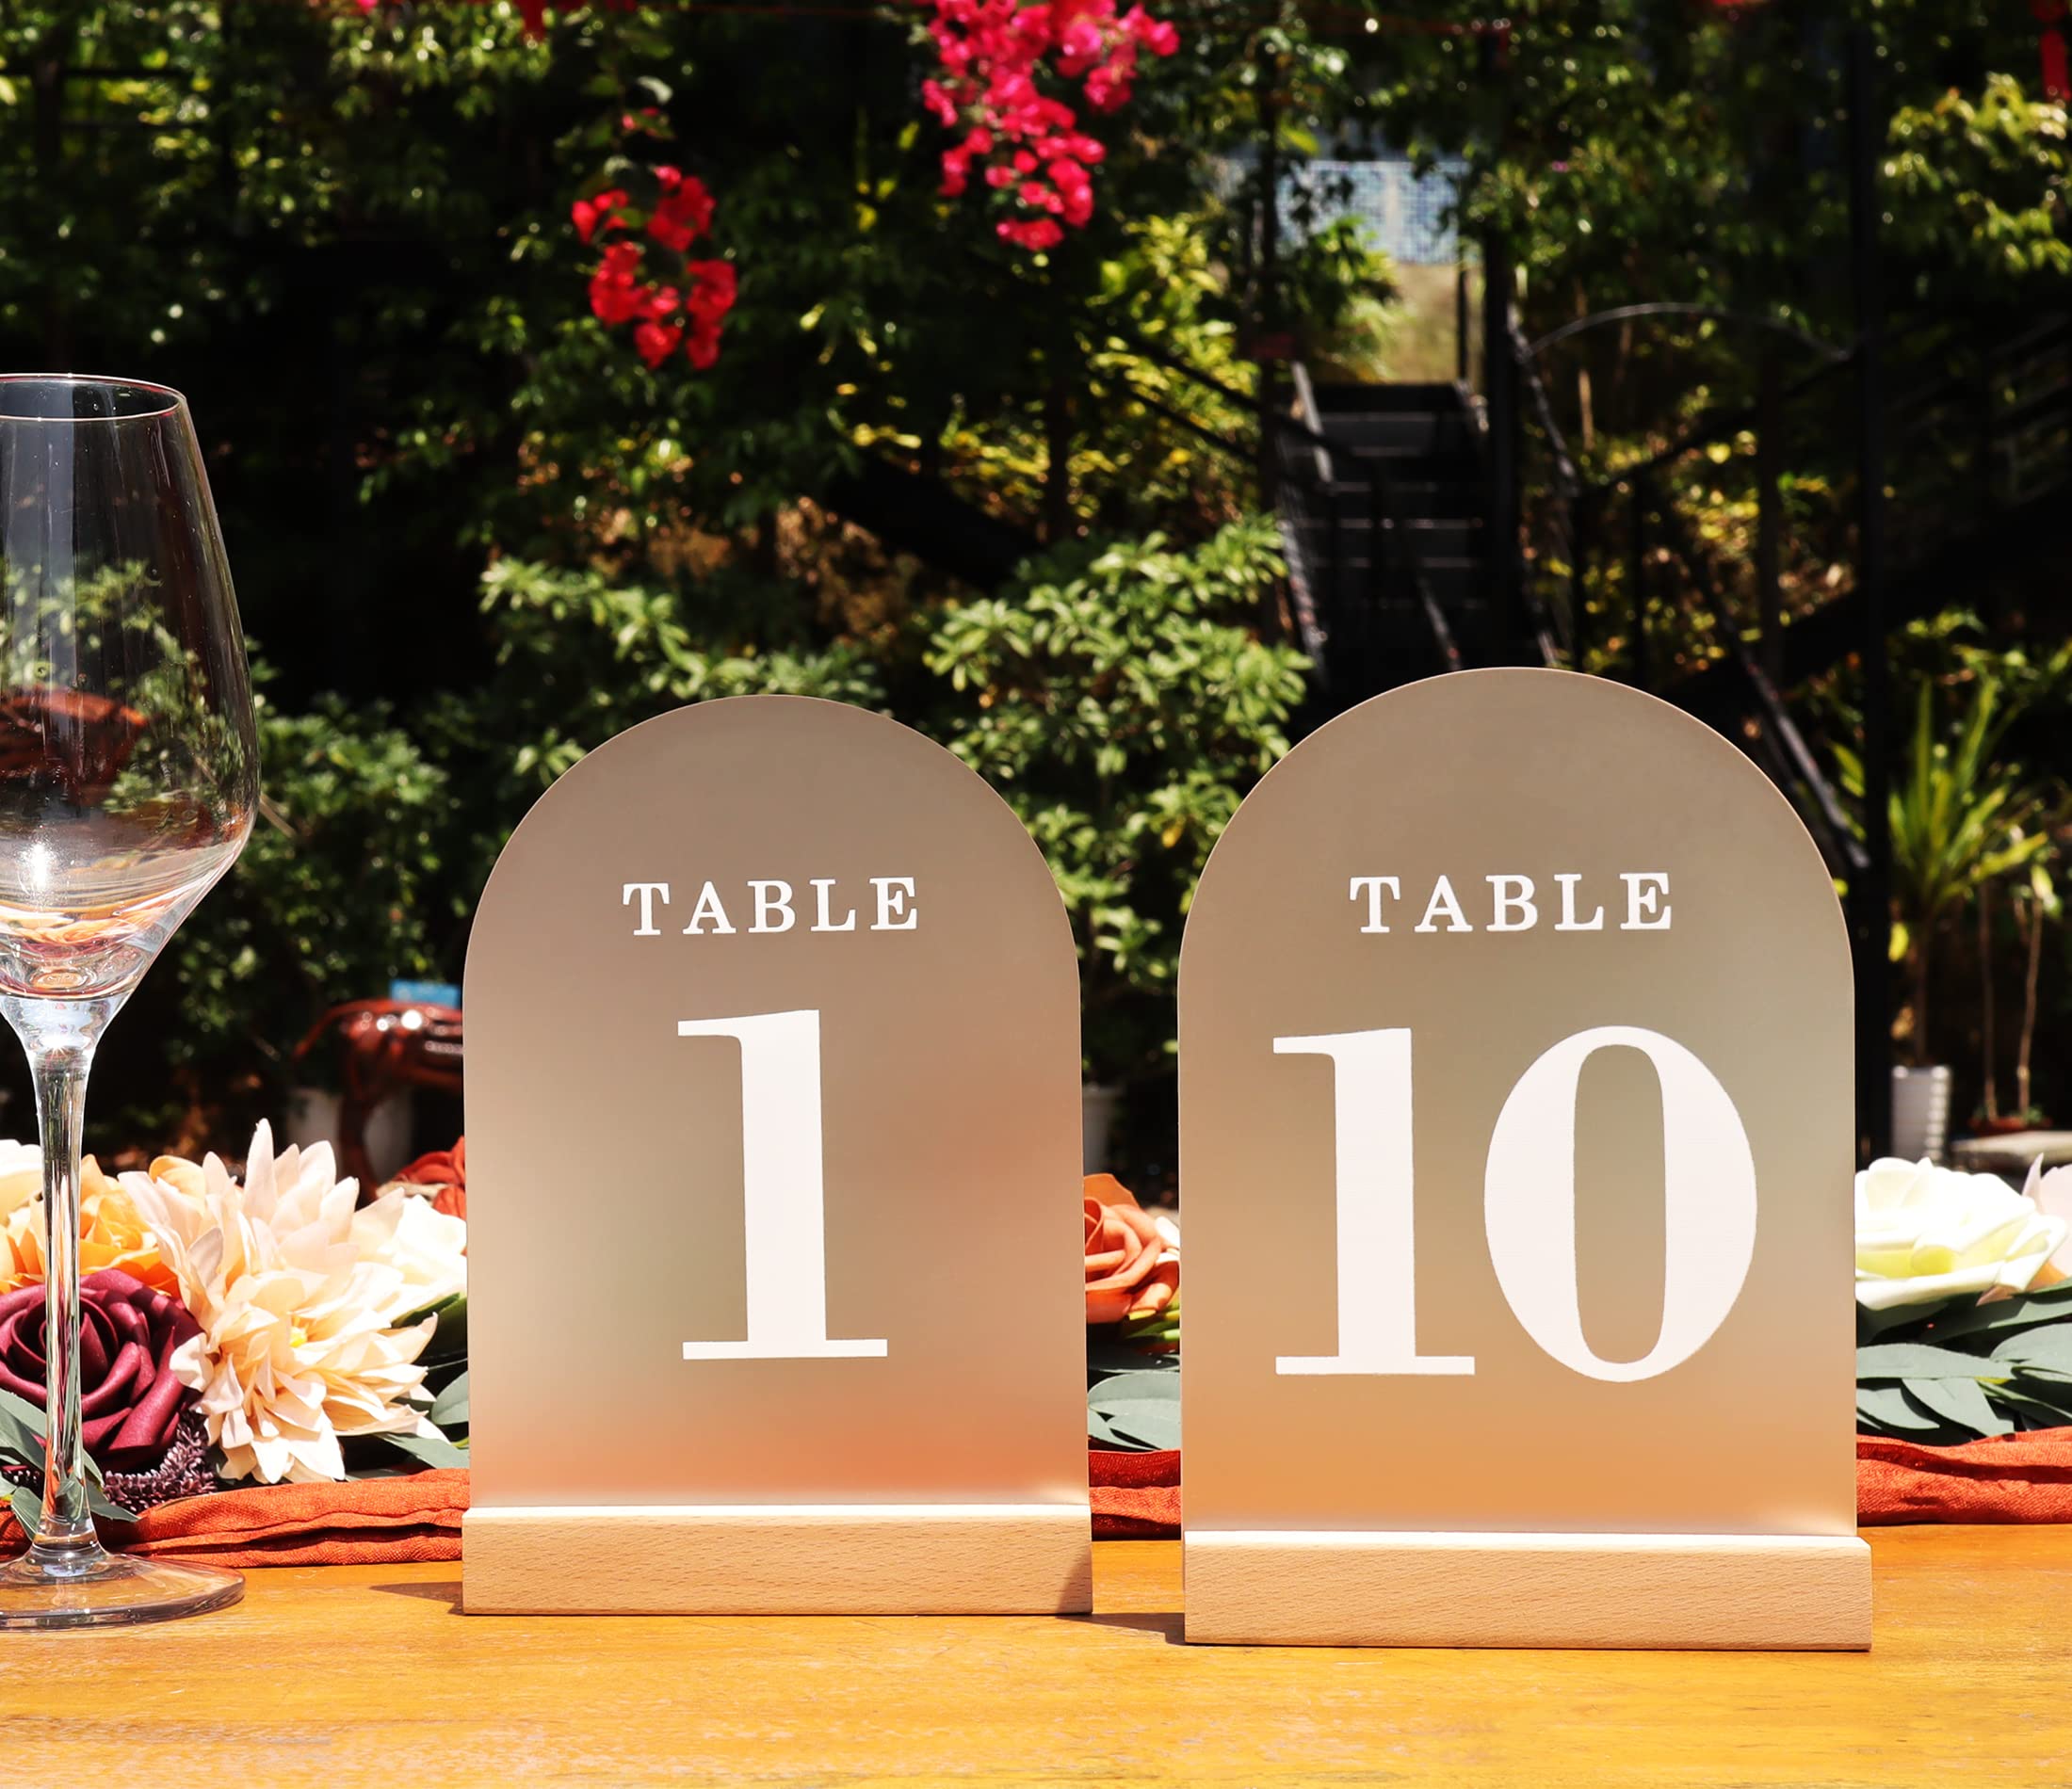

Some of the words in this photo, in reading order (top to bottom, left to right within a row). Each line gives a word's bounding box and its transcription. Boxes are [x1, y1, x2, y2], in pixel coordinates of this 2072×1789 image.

[623, 877, 917, 936] TABLE
[1350, 872, 1672, 933] TABLE
[677, 1009, 888, 1360] 1
[1272, 1025, 1758, 1383] 10
